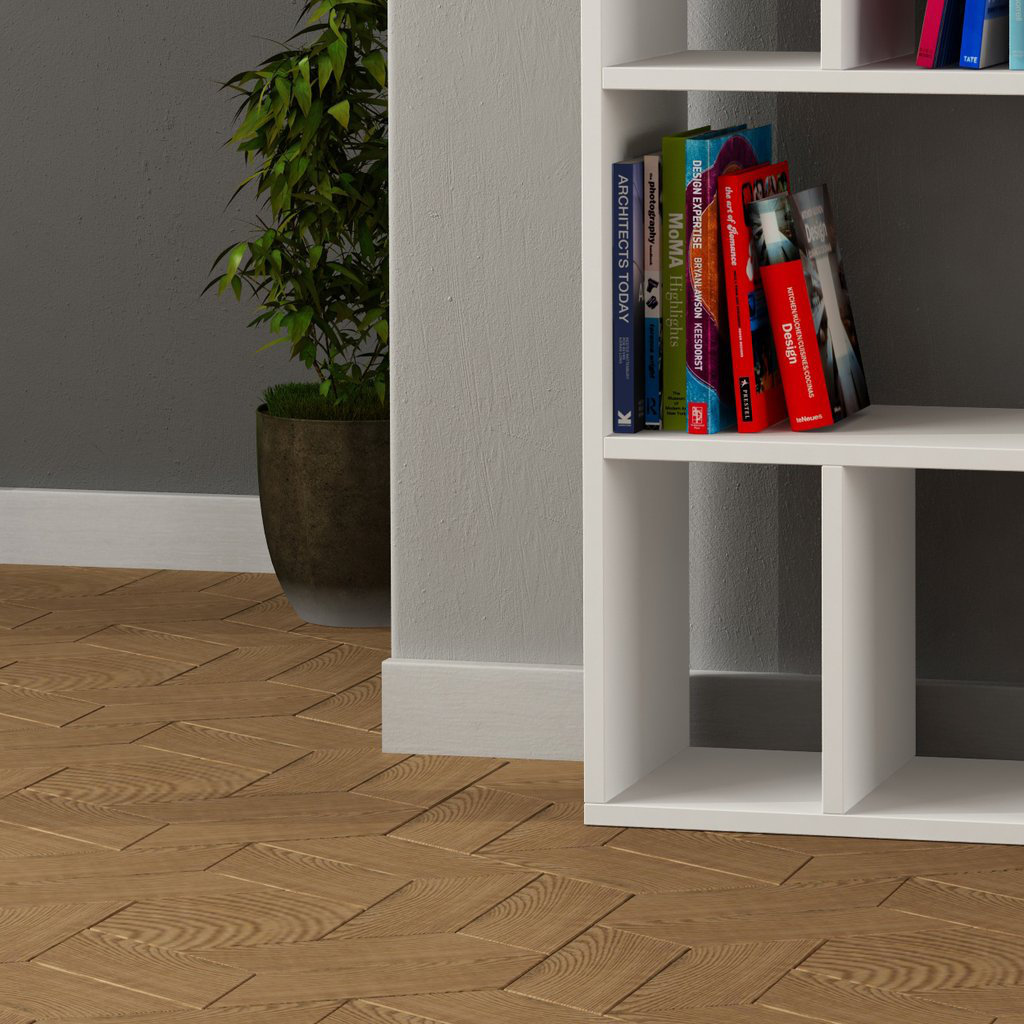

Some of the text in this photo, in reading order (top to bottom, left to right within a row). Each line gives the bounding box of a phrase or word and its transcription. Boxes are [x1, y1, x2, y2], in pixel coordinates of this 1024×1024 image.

[692, 160, 702, 195] DESIGN
[725, 186, 733, 199] the
[648, 181, 657, 244] photography
[692, 197, 702, 249] EXPERTISE
[726, 201, 734, 213] art
[727, 215, 736, 224] of
[618, 175, 629, 323] ARCHITECTS TODAY
[727, 224, 738, 266] Romance
[666, 213, 683, 347] MoMA Highlights
[694, 323, 702, 371] KEESDORST
[782, 323, 798, 364] Design
